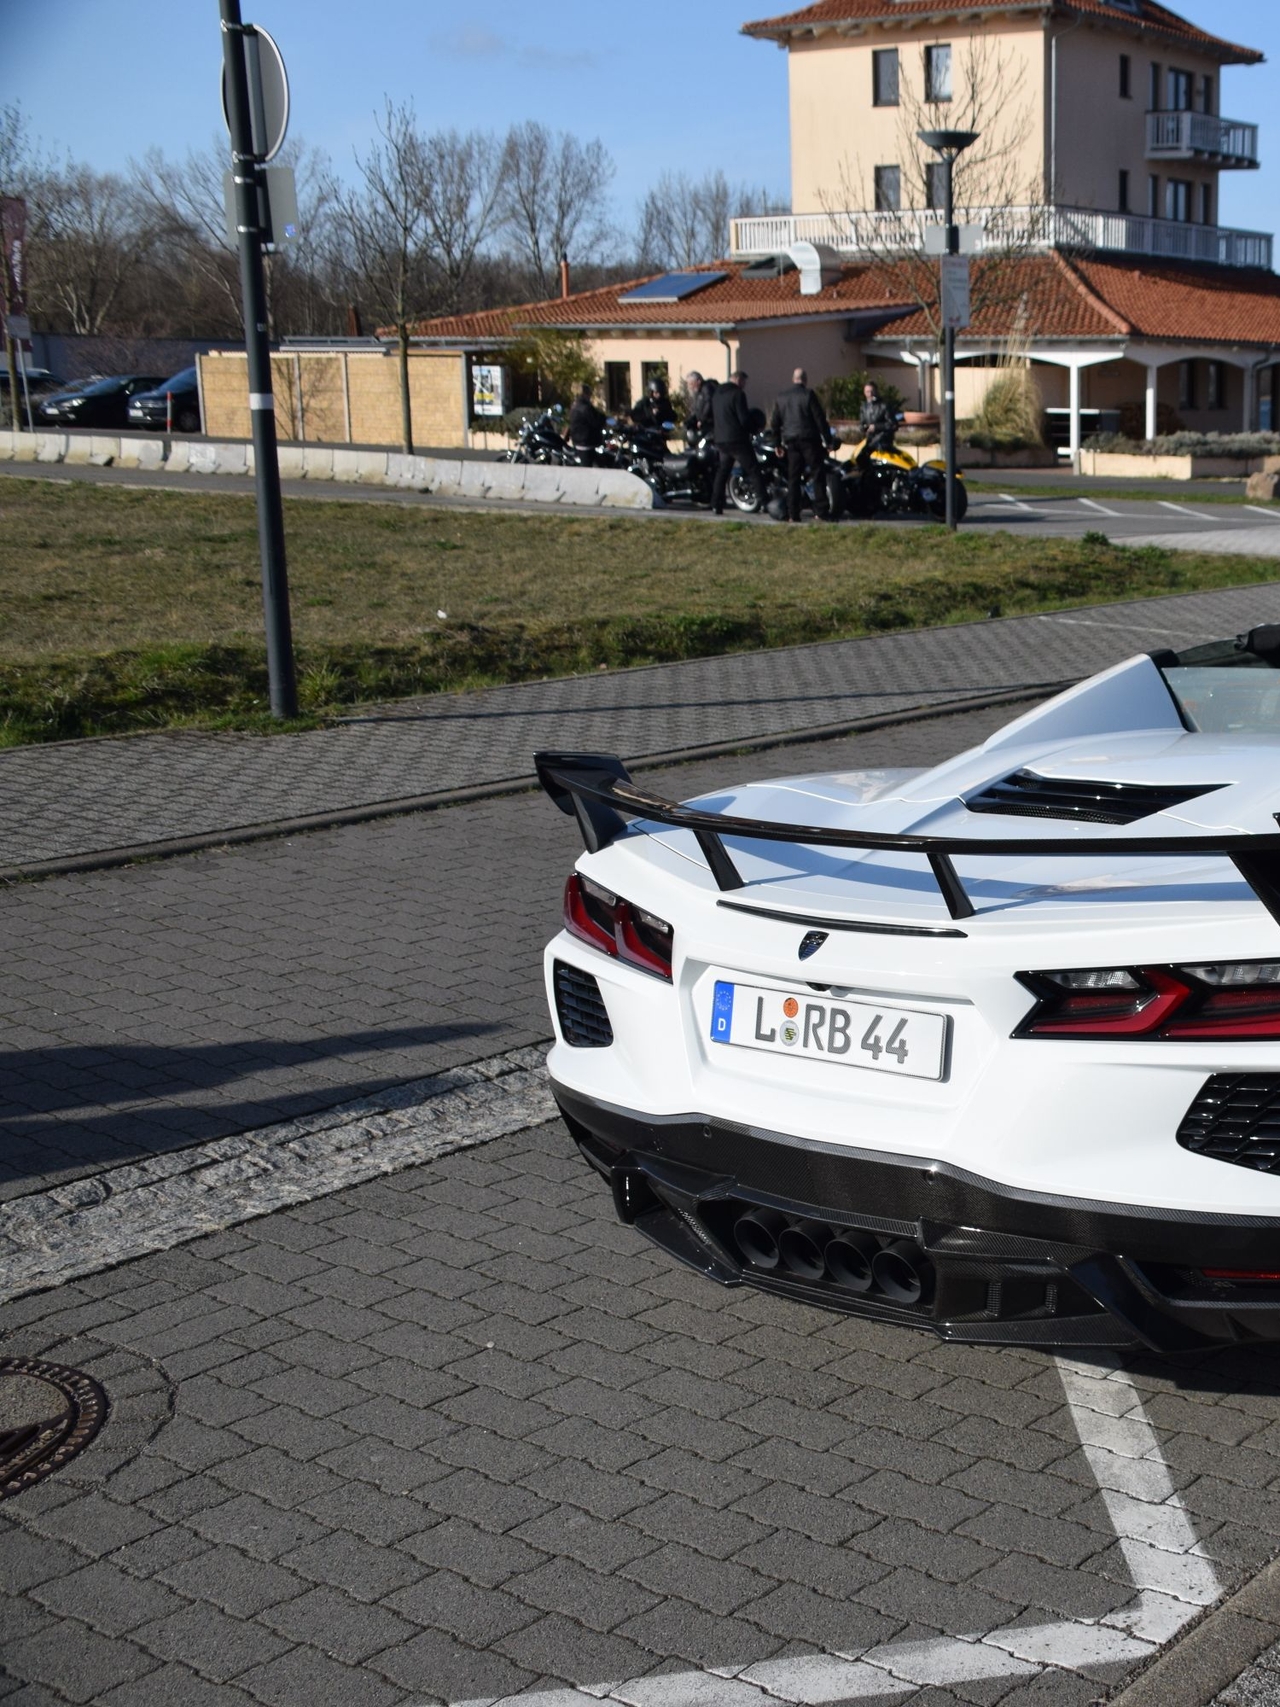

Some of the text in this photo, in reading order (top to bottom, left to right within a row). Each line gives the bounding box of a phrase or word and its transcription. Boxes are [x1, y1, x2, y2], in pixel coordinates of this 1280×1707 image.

[718, 1017, 726, 1031] D
[755, 996, 909, 1064] L RB 44
